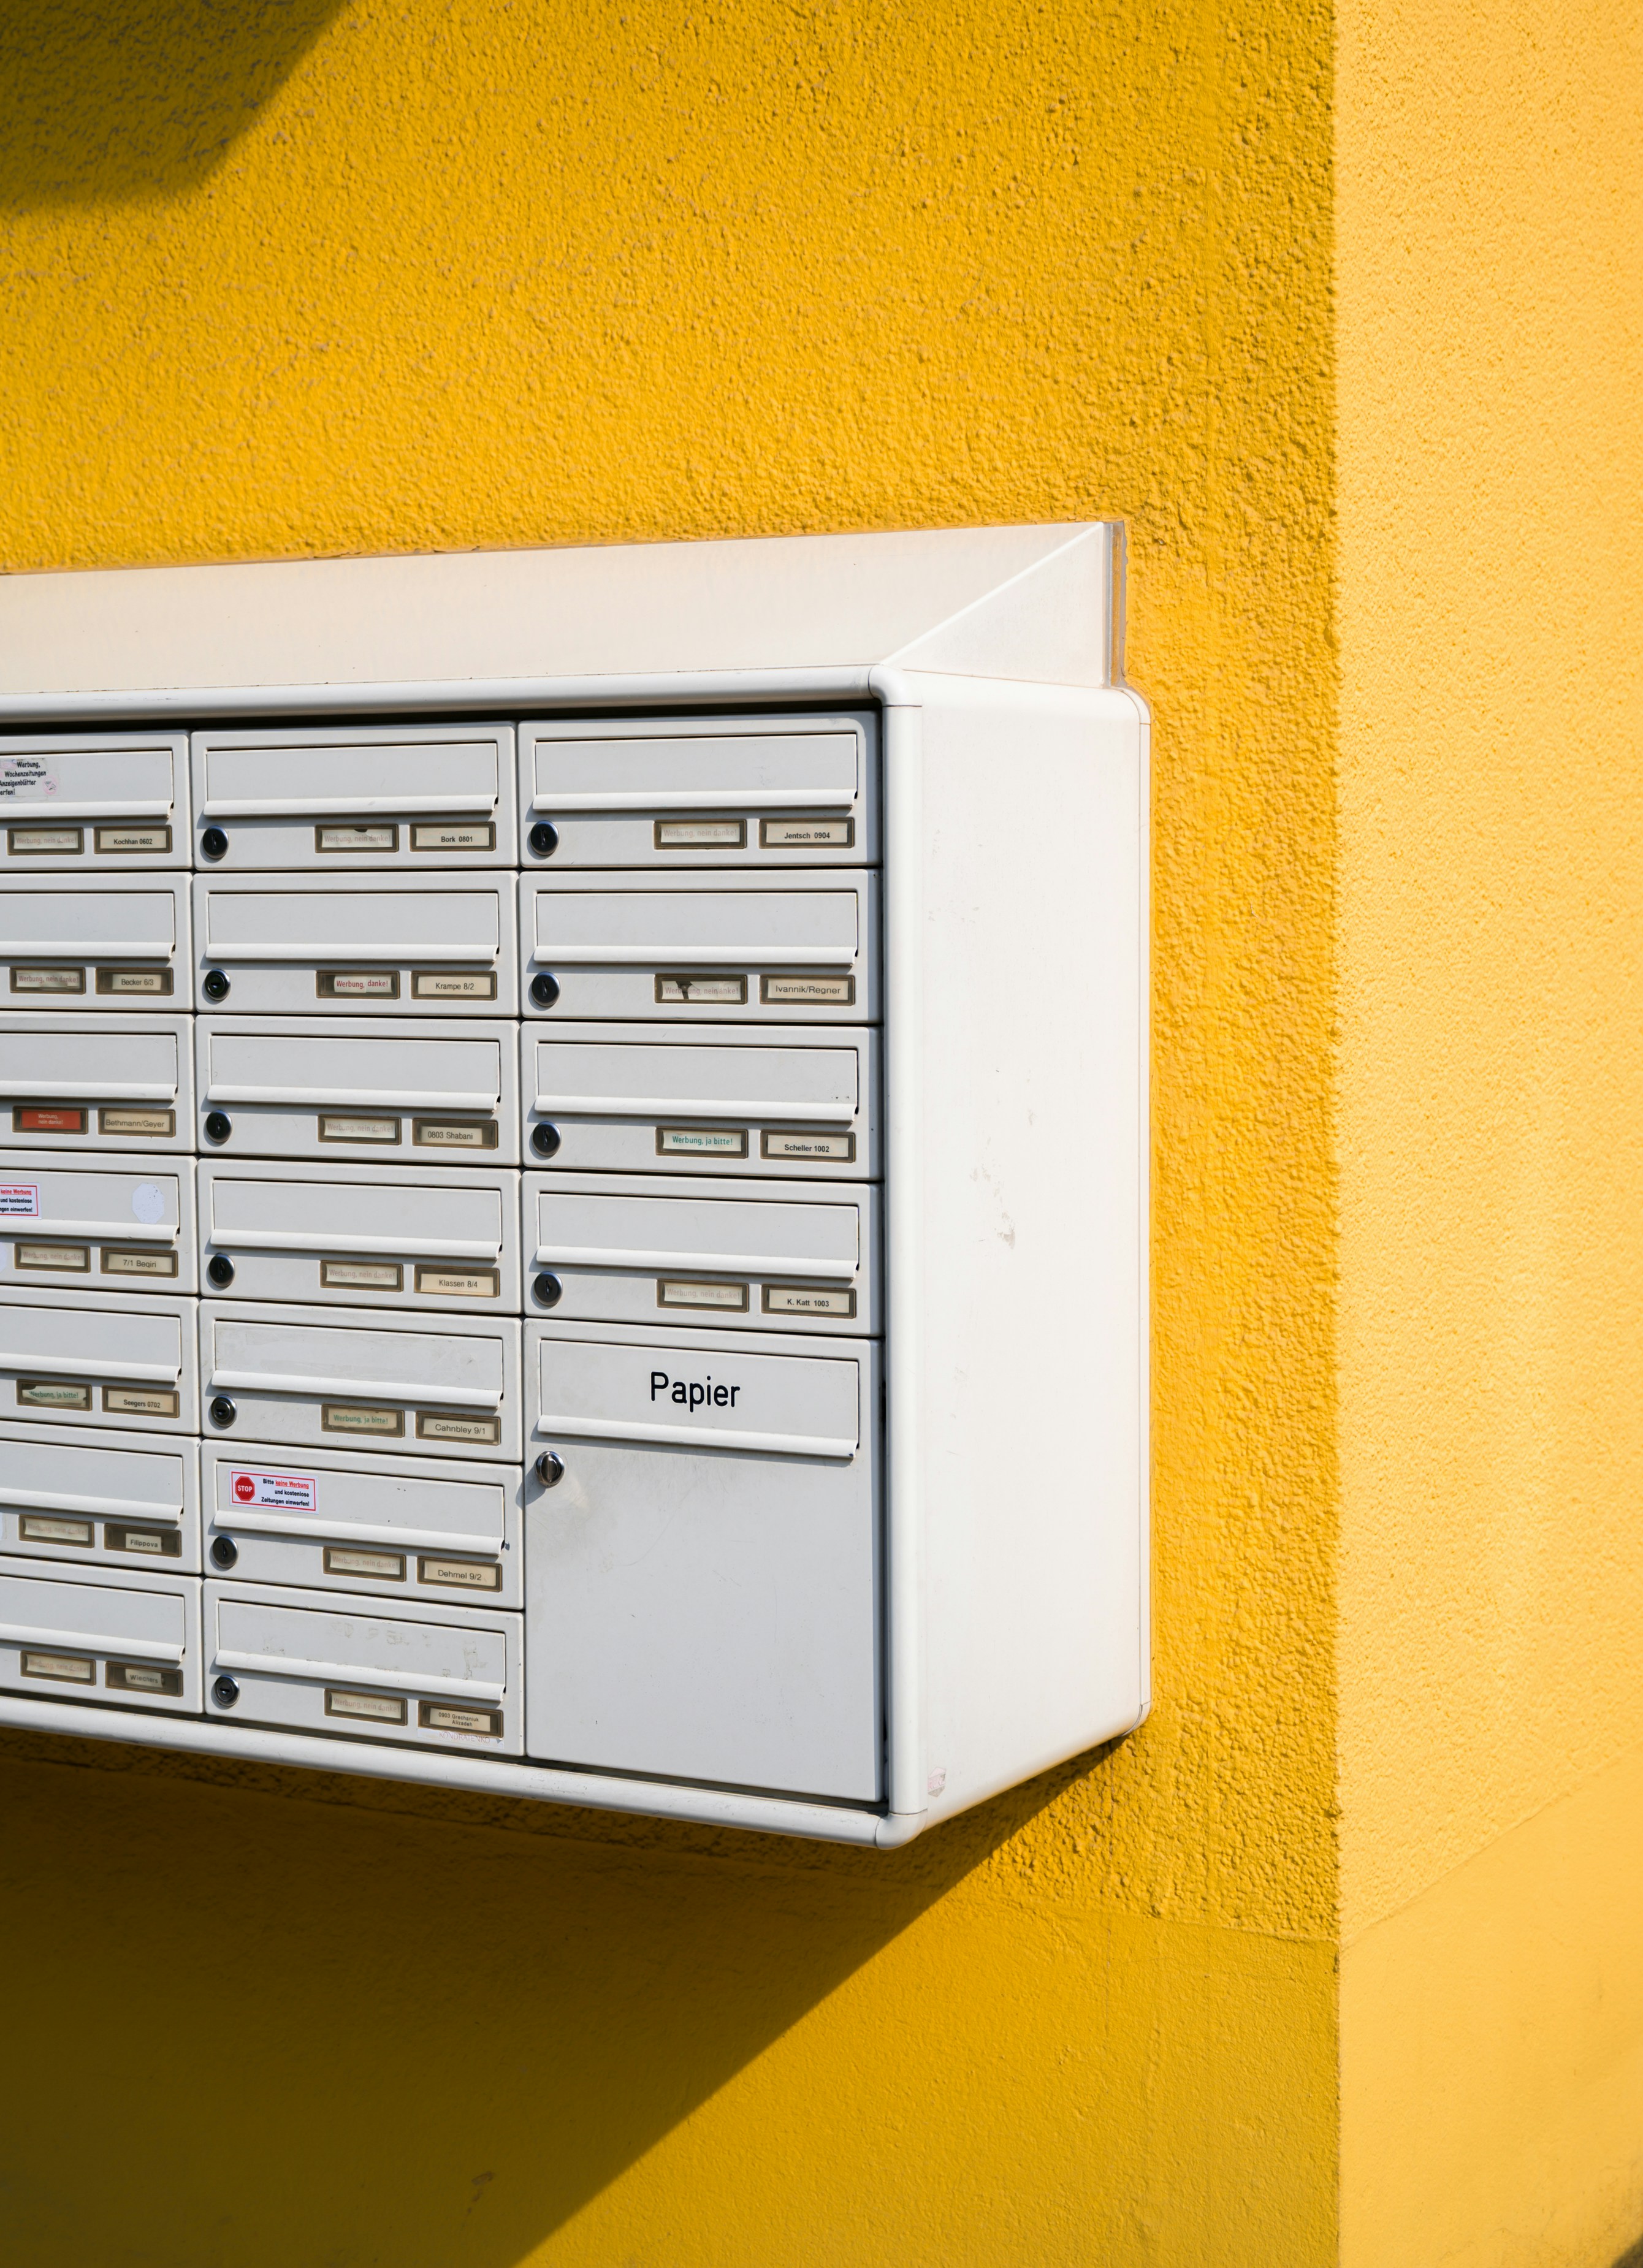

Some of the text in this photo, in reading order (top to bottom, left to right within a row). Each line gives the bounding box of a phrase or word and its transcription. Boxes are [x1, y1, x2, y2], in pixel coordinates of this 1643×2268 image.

[663, 830, 694, 839] Werbung,
[776, 985, 841, 994] Ivannik/Regner
[106, 1119, 164, 1128] Bethmann/Geyer
[327, 1123, 356, 1132] Werbung,
[672, 1136, 703, 1146] Werbung,
[706, 1137, 712, 1146] ja
[23, 1251, 48, 1260] Werbung,
[329, 1269, 357, 1279] Werbung,
[439, 1279, 465, 1287] Klassen
[667, 1288, 698, 1298] Werbung,
[717, 1290, 739, 1300] danke!
[651, 1371, 741, 1413] Papier
[334, 1414, 362, 1423] Werbung,
[435, 1424, 471, 1435] Cahnbley
[289, 1481, 309, 1490] Werbung
[261, 1496, 284, 1505] Zeitungen
[67, 1527, 86, 1535] danke!
[130, 1539, 158, 1548] Filippova
[332, 1555, 360, 1566] Werbung,
[377, 1560, 398, 1569] danke!
[438, 1569, 482, 1581] Dehmel 9/2
[69, 1664, 89, 1673] danke!
[130, 1675, 158, 1683] Wiechers
[334, 1697, 362, 1709] Werbung,
[378, 1703, 399, 1712] danke!
[439, 1731, 490, 1744] KONDRATENKO
